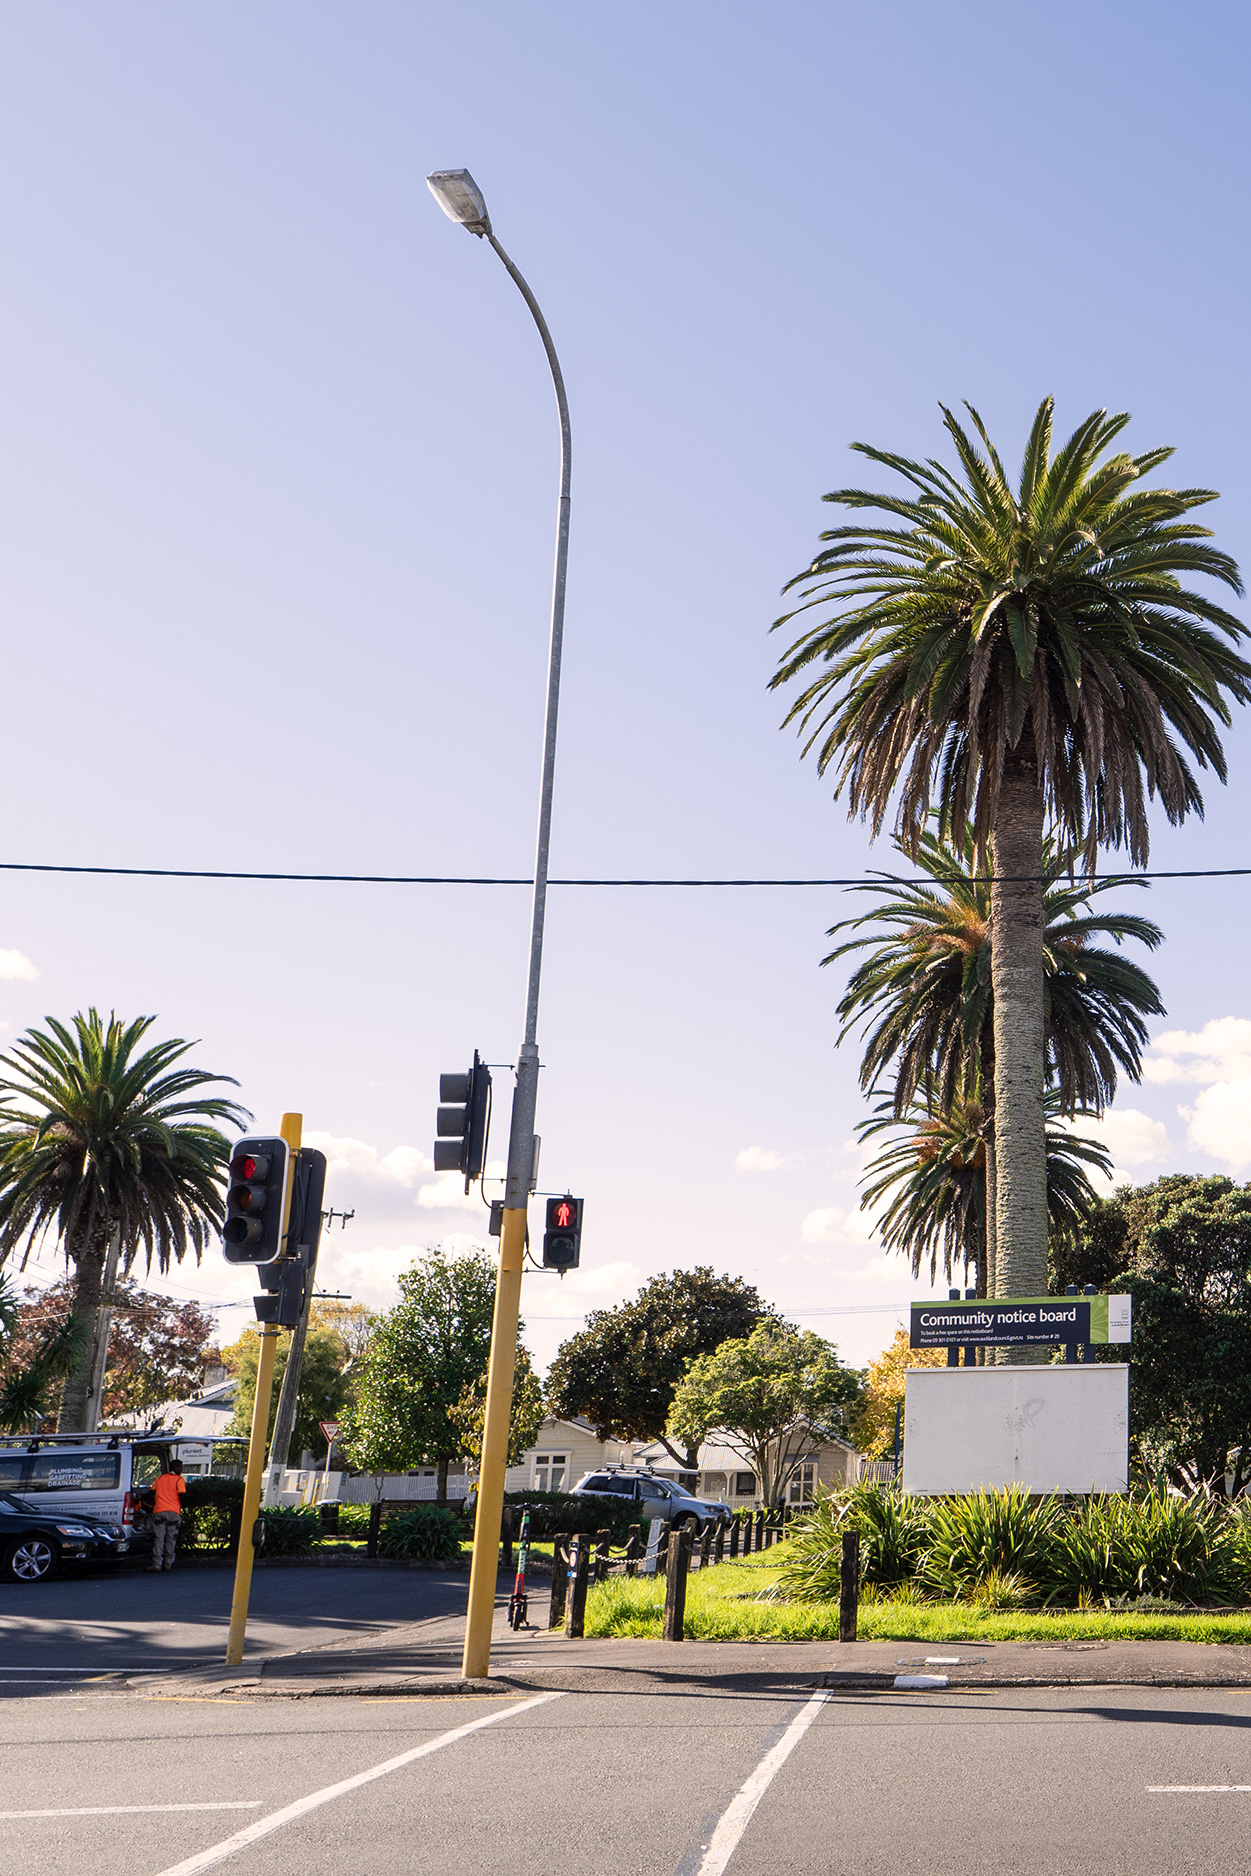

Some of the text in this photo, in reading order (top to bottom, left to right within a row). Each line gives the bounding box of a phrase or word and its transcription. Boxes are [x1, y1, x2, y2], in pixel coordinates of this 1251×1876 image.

[920, 1307, 1076, 1328] Community notice board
